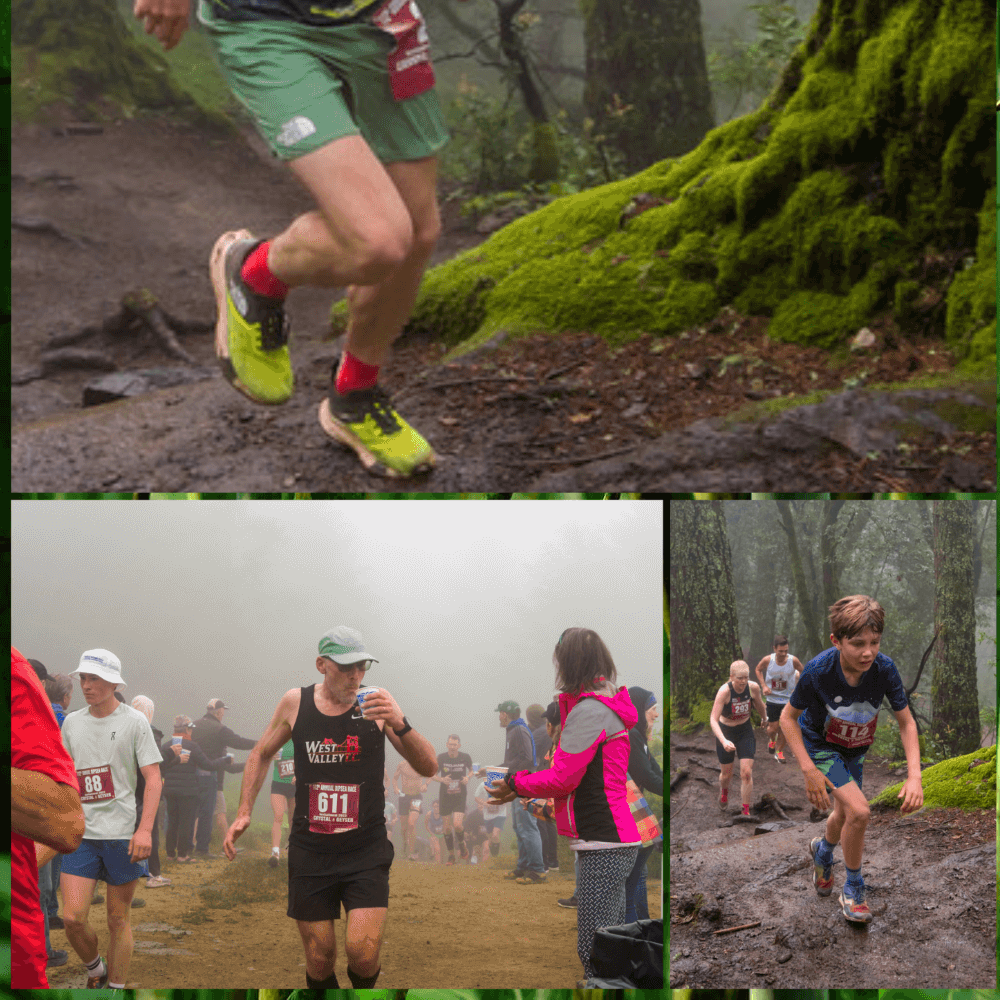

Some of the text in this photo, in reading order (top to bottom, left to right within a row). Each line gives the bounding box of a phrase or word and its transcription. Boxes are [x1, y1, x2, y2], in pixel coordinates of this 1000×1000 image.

[734, 703, 749, 714] 293
[840, 725, 869, 738] 114
[84, 774, 103, 793] 88
[317, 792, 348, 814] 611
